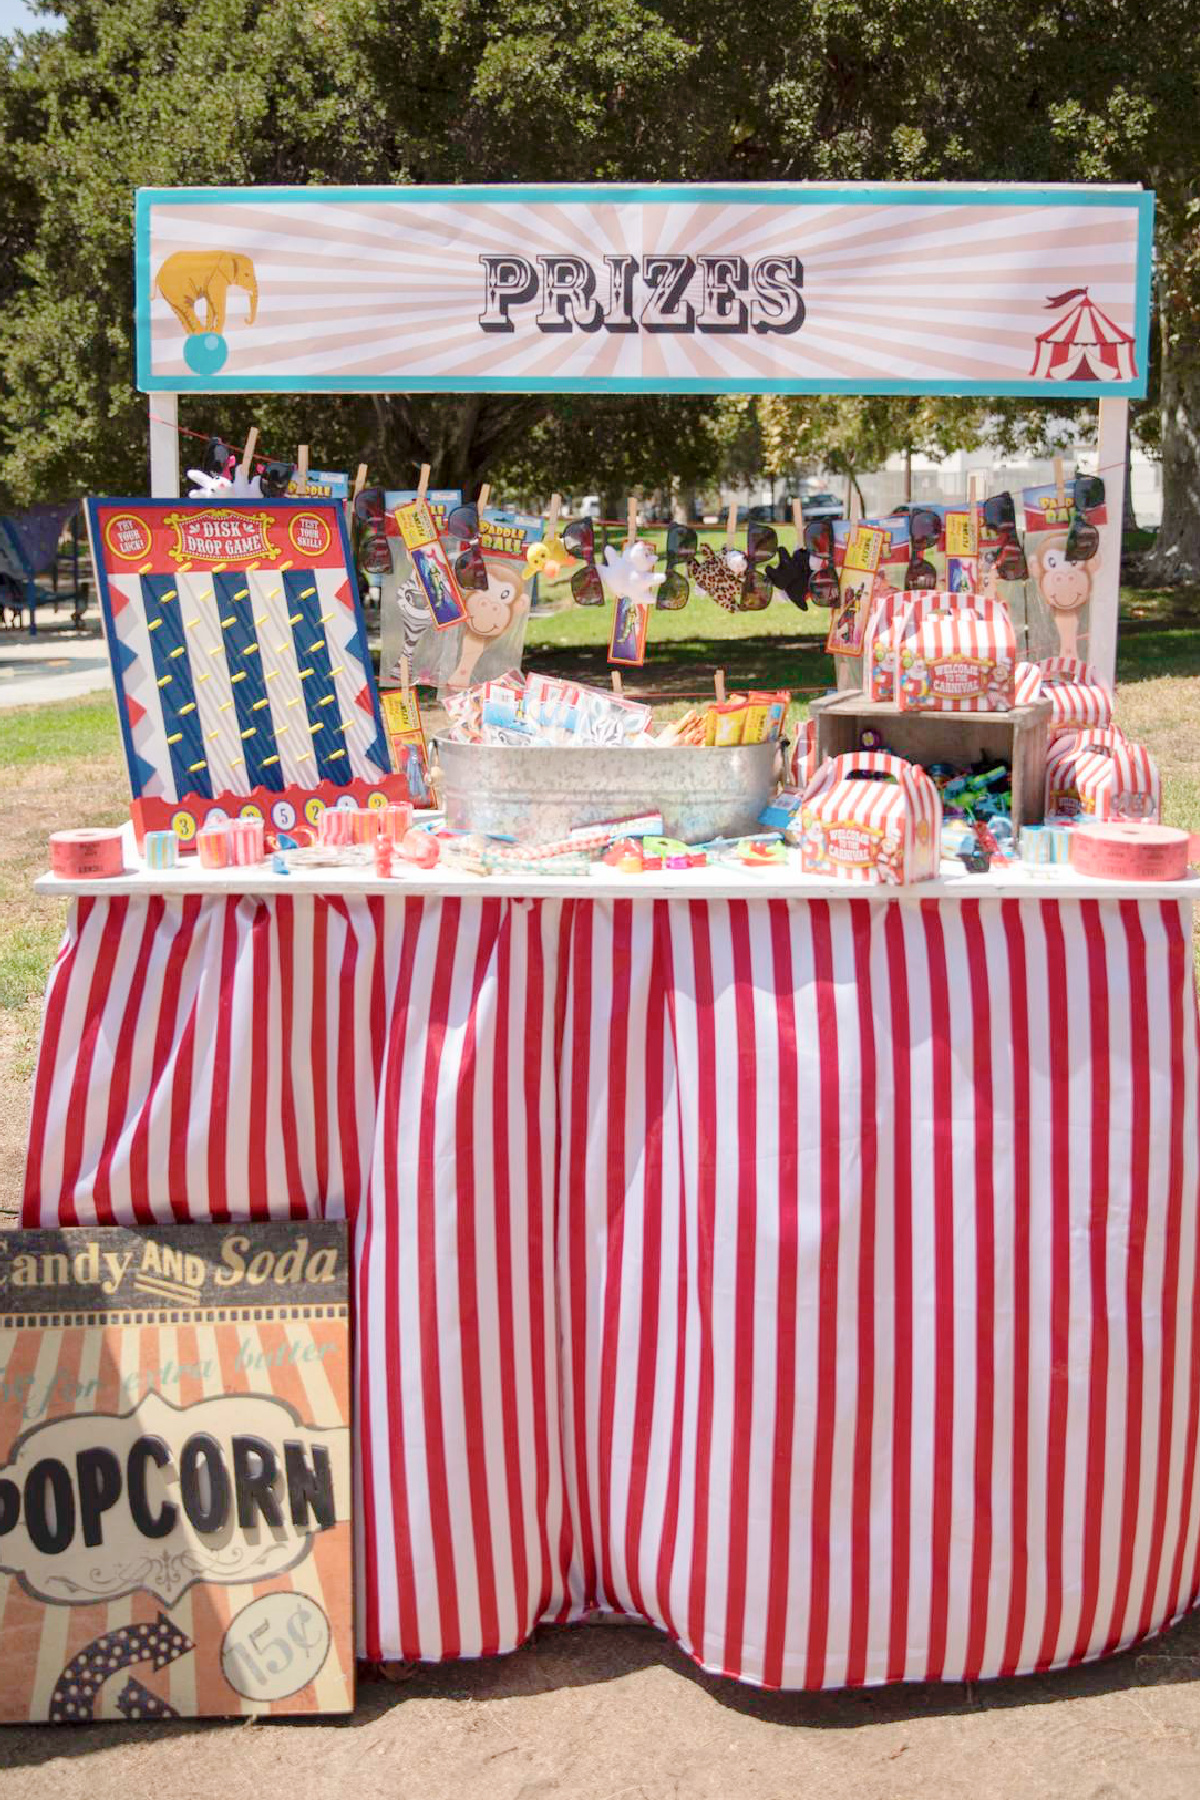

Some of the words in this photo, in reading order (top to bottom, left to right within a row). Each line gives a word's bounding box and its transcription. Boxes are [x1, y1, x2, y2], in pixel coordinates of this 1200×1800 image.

[478, 254, 805, 334] PRIZES
[202, 521, 242, 538] DISK
[299, 518, 319, 529] TEST
[117, 529, 141, 542] YOUR
[300, 528, 319, 538] YOUR
[187, 535, 223, 553] DROP
[225, 535, 261, 554] GAME
[933, 680, 979, 694] CARNIVAL
[280, 808, 288, 825] 5
[138, 1241, 207, 1288] AND
[214, 1234, 338, 1287] Soda
[235, 1338, 338, 1373] butter
